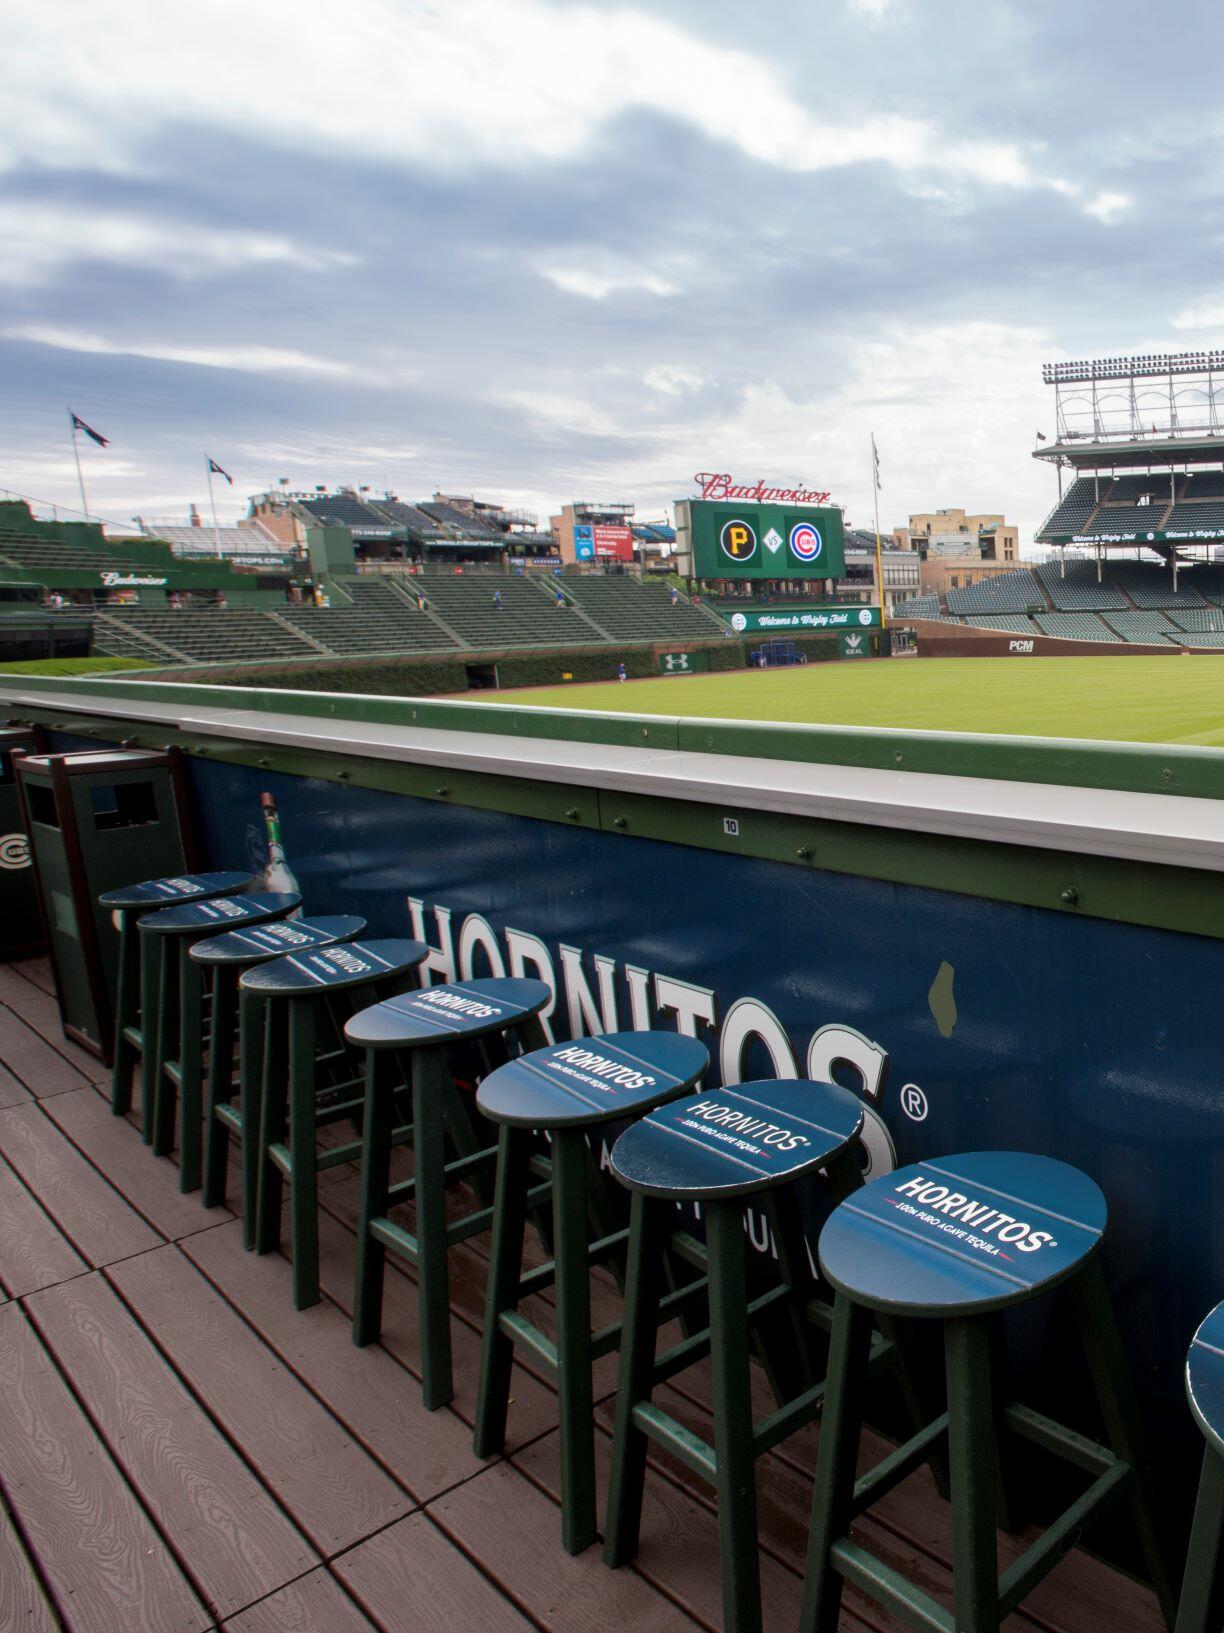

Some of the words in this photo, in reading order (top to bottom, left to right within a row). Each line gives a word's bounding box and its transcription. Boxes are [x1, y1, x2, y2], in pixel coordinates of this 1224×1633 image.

[695, 472, 831, 502] Budweiser
[730, 527, 748, 554] P
[768, 535, 778, 546] VS
[1101, 534, 1121, 542] Wrigley
[1196, 530, 1216, 538] Wrigley
[100, 572, 168, 586] Budweiser
[758, 616, 791, 626] Welcome
[793, 615, 799, 625] to
[800, 614, 828, 626] Wrigley
[829, 614, 848, 624] Field
[1009, 640, 1034, 652] PCM
[726, 820, 737, 833] 10
[261, 924, 314, 944] HORNITOS
[320, 947, 371, 973] HORNITOS
[416, 989, 501, 1018] HORNITOS
[552, 1046, 655, 1089] HORNITOS
[915, 1211, 940, 1225] PURO
[937, 1223, 968, 1239] AGAVE
[964, 1234, 1000, 1256] TEQUILA
